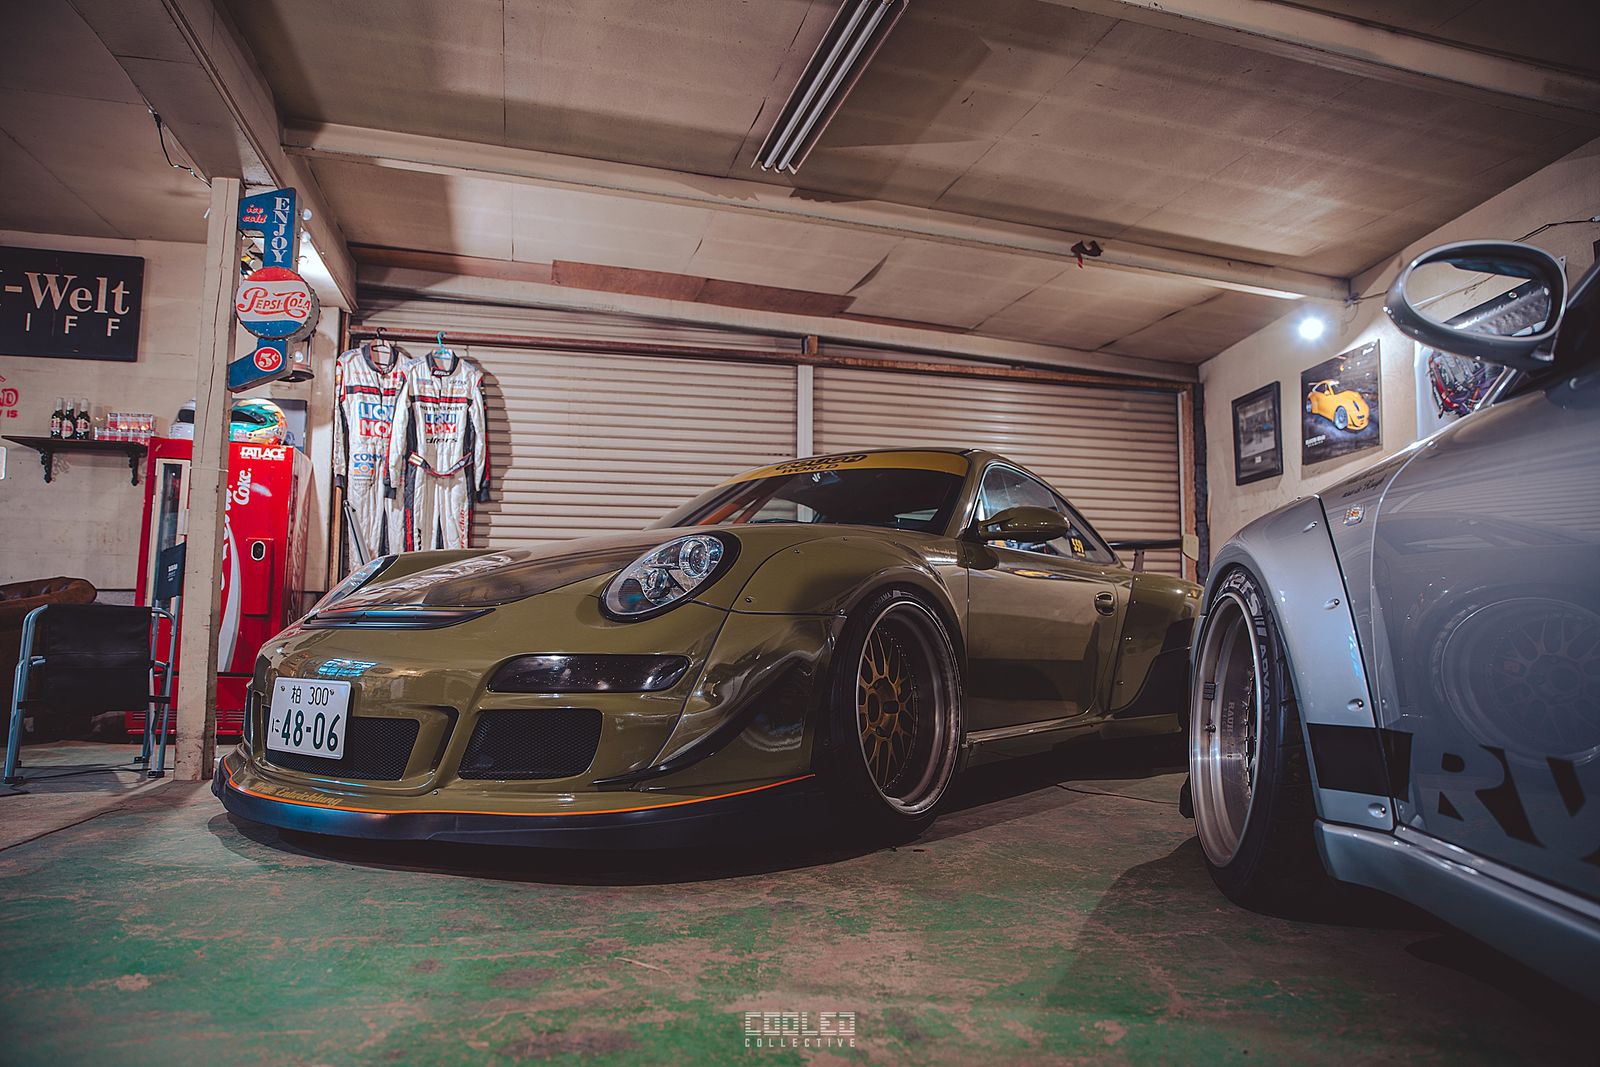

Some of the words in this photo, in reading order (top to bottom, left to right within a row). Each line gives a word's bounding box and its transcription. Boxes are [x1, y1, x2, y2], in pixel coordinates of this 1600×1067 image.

[242, 214, 268, 223] cold
[246, 204, 264, 214] ice
[272, 196, 290, 263] ENJOY
[0, 271, 130, 315] -Welt
[360, 420, 392, 438] MO
[240, 446, 285, 461] FATLACE
[1260, 644, 1271, 720] ADVAN
[308, 686, 330, 706] 300
[271, 717, 281, 733] に
[281, 709, 341, 752] 48-06
